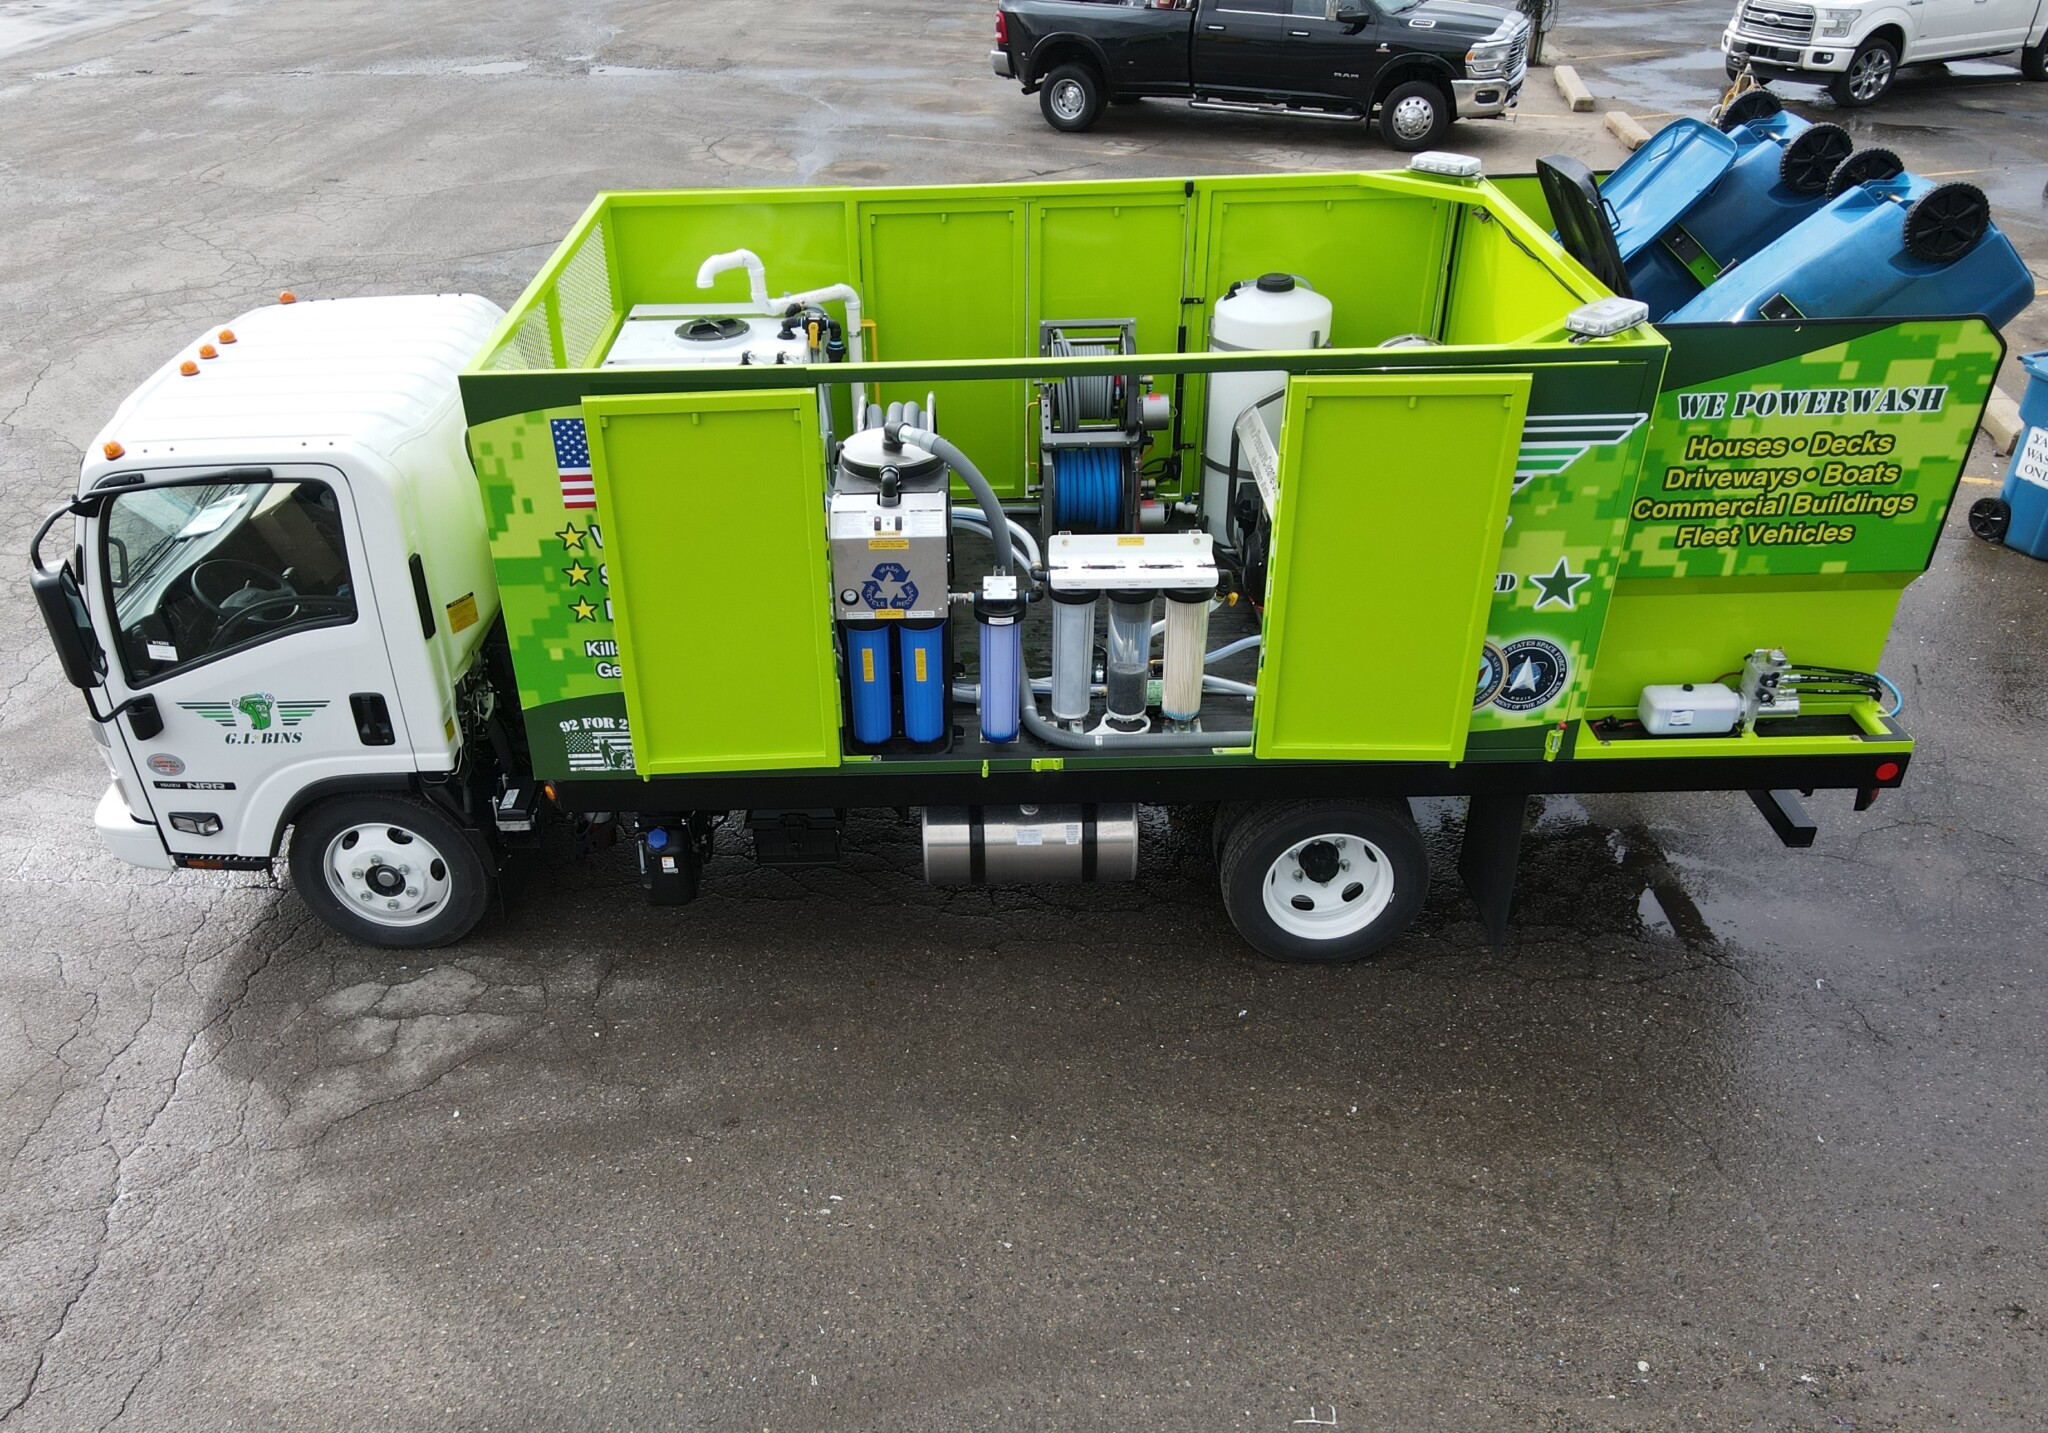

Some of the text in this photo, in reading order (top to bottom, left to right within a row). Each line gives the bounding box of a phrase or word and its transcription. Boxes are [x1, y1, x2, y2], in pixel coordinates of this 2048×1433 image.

[1677, 386, 1947, 420] WE POWERWASH
[1686, 432, 1894, 460] Houses Decks
[1664, 463, 1900, 493] Driveways Boats
[1633, 493, 1916, 520] Commercial Buildings
[1675, 523, 1855, 548] Fleet Vehicles
[879, 565, 900, 574] WASH
[866, 585, 885, 606] RECYCLE
[896, 585, 914, 607] RECOVER
[1508, 640, 1536, 652] STATES
[1536, 641, 1557, 654] SPACE
[1555, 651, 1566, 672] FORCE
[1522, 701, 1535, 709] THE
[559, 717, 630, 732] 92 FOR 2
[261, 732, 302, 744] BINS
